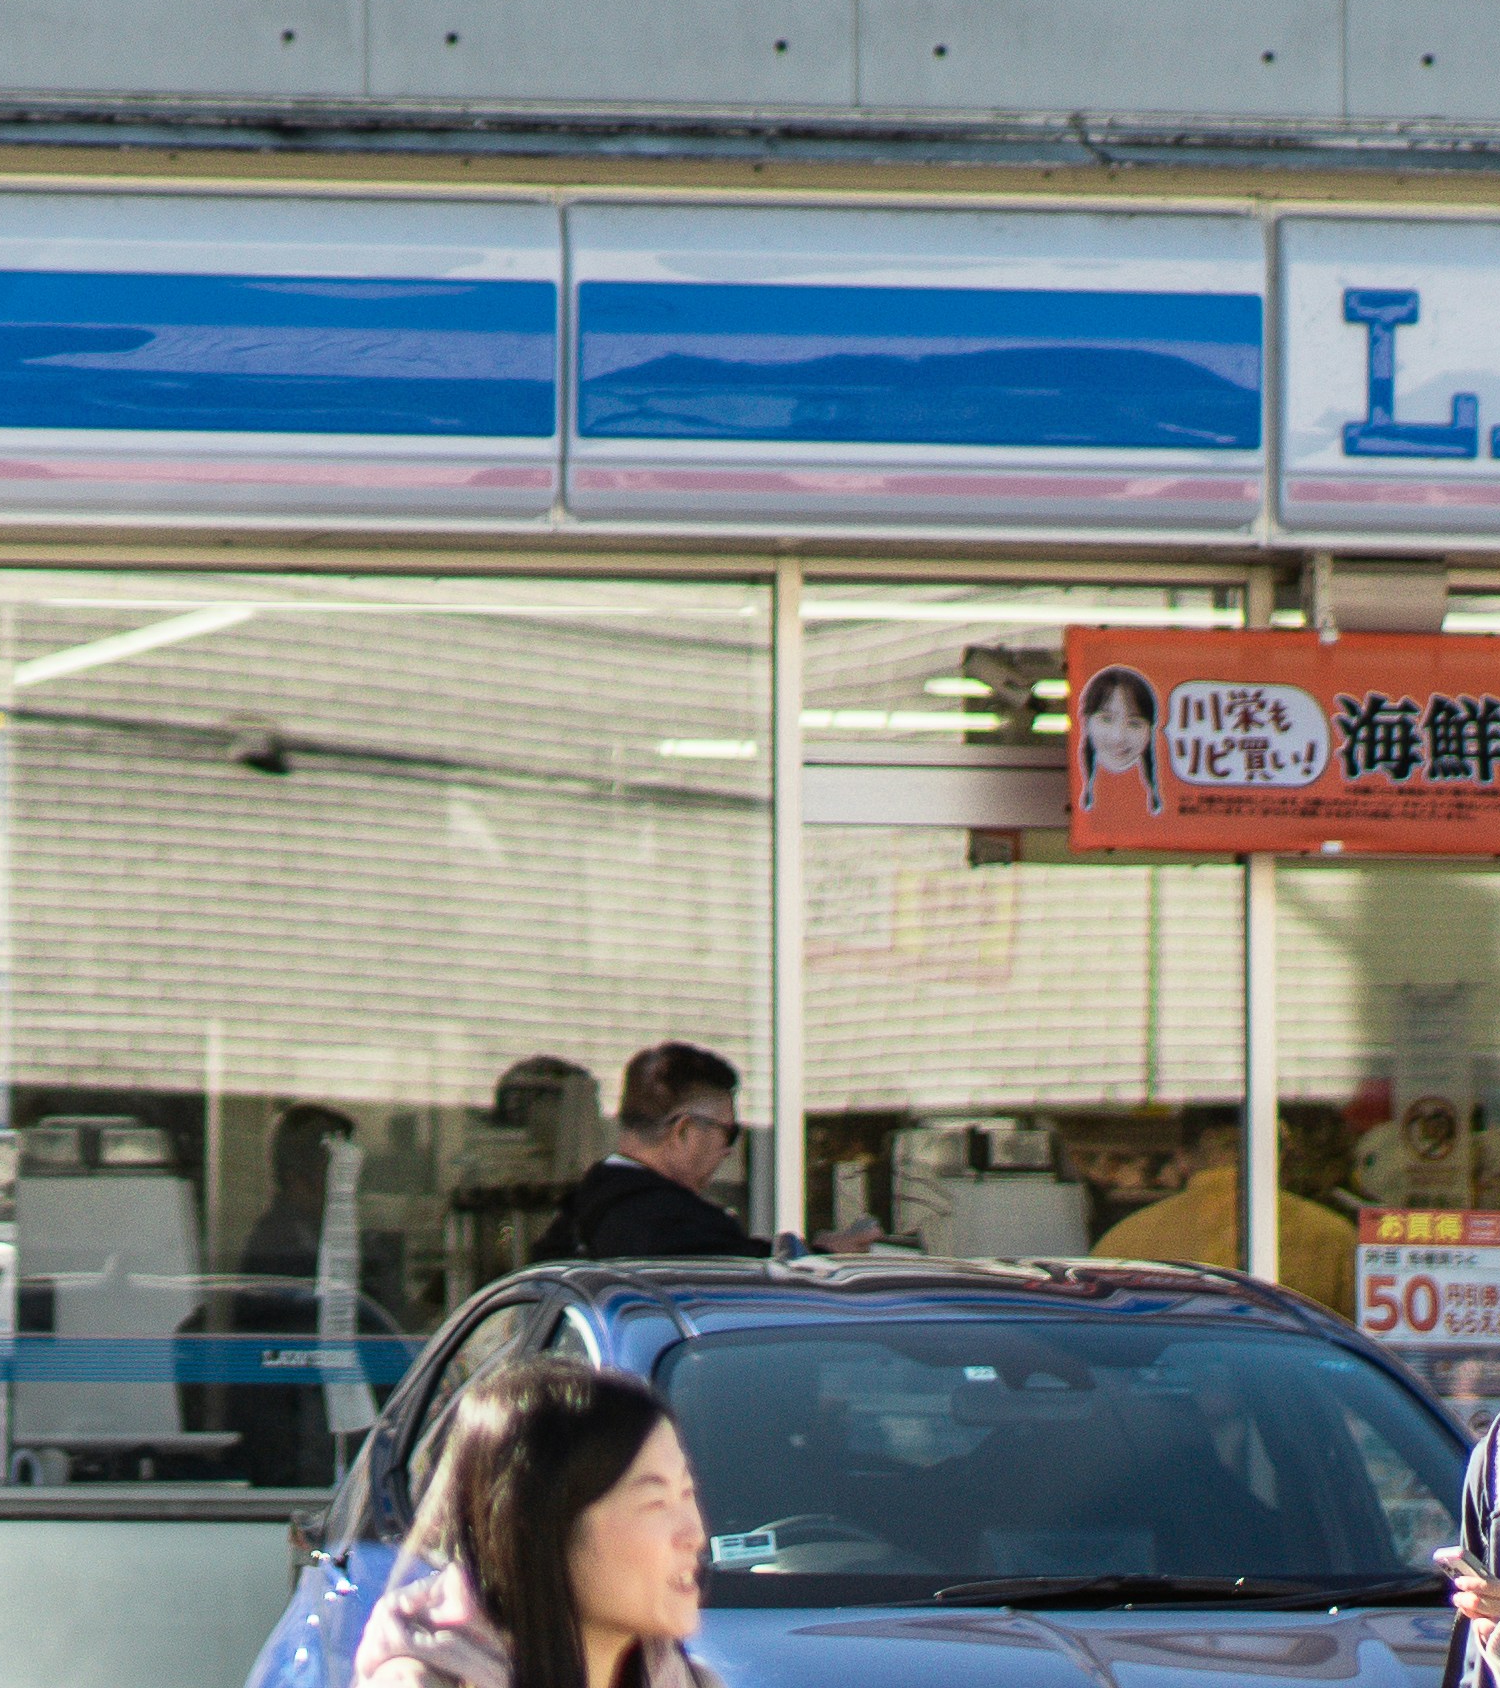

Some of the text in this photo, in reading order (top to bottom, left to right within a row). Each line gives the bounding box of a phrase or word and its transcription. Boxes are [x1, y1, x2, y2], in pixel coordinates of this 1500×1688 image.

[1178, 687, 1292, 733] 川栄も
[1174, 735, 1315, 781] リピ買い!
[1363, 1273, 1440, 1334] 50
